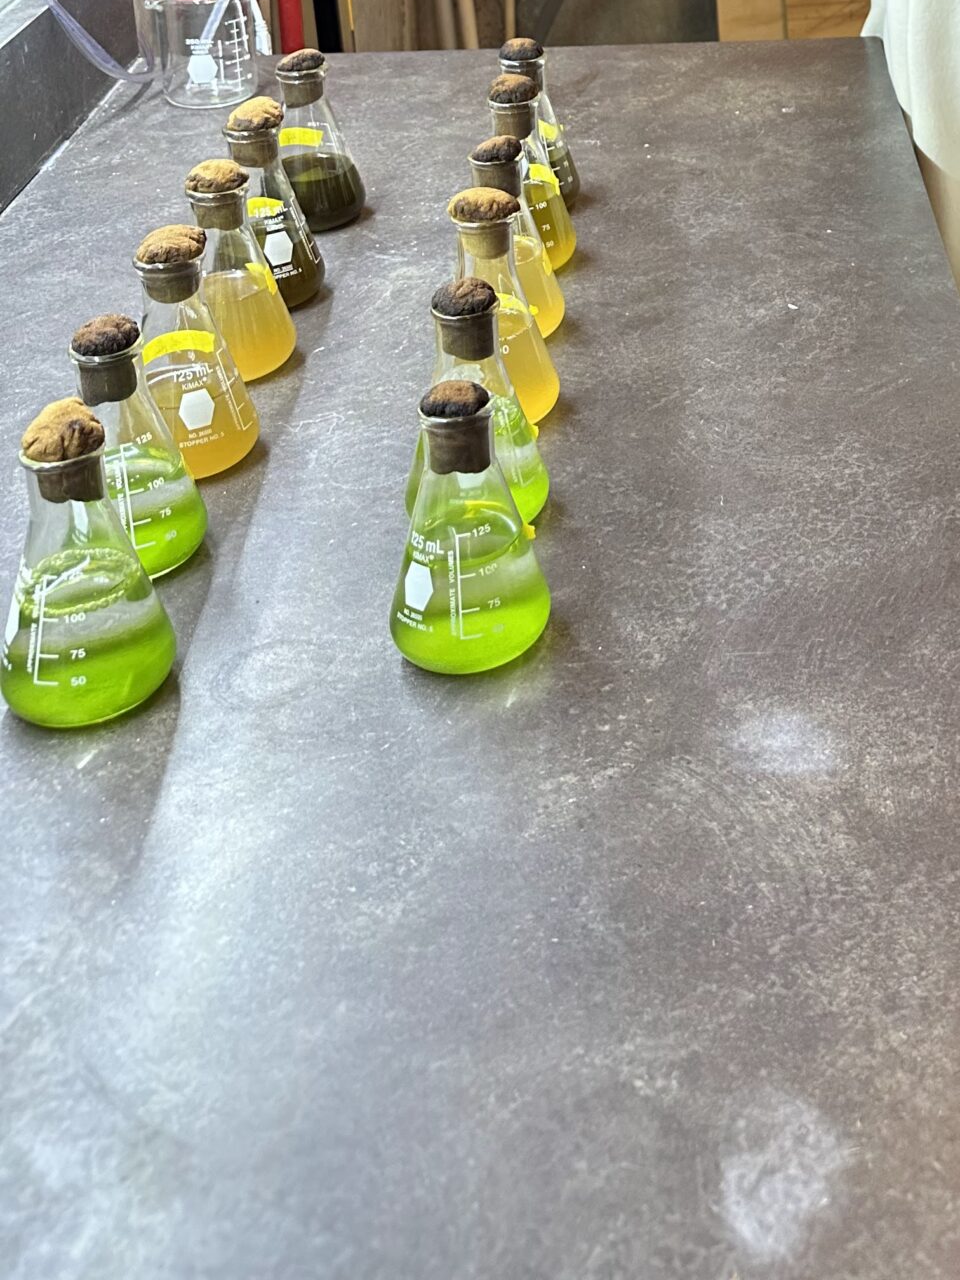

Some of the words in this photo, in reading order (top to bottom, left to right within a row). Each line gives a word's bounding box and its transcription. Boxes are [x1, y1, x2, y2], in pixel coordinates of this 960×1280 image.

[535, 200, 548, 210] 100
[541, 223, 551, 232] 75
[136, 431, 153, 446] 125
[147, 476, 166, 491] 100
[159, 507, 172, 519] 75
[471, 523, 491, 538] 125
[425, 539, 445, 555] mL
[487, 596, 501, 609] 75
[63, 612, 86, 624] 100
[69, 648, 87, 660] 75
